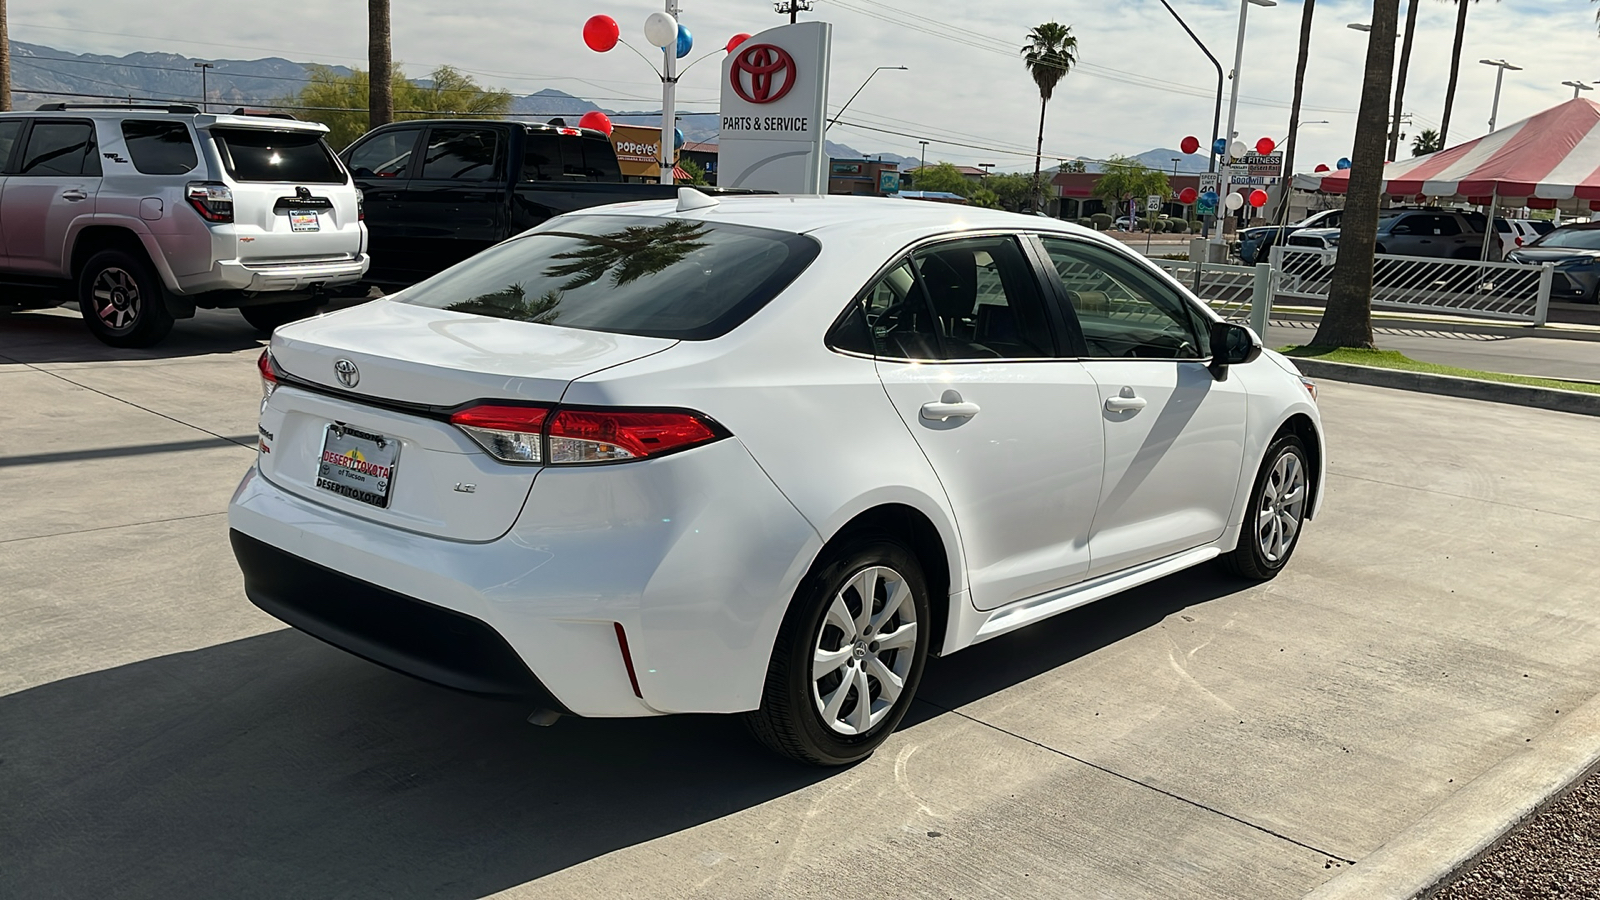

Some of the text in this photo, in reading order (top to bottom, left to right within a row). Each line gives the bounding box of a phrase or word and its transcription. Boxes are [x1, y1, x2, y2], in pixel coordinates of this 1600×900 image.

[722, 117, 807, 131] PARTS & SERVICE
[1248, 156, 1280, 164] FITNESS
[1231, 175, 1264, 184] Goodwill
[323, 451, 389, 479] DESERT TOYOTA
[345, 470, 366, 482] Tucson
[316, 478, 383, 505] DESERT TOYOTA
[453, 482, 477, 493] LE
